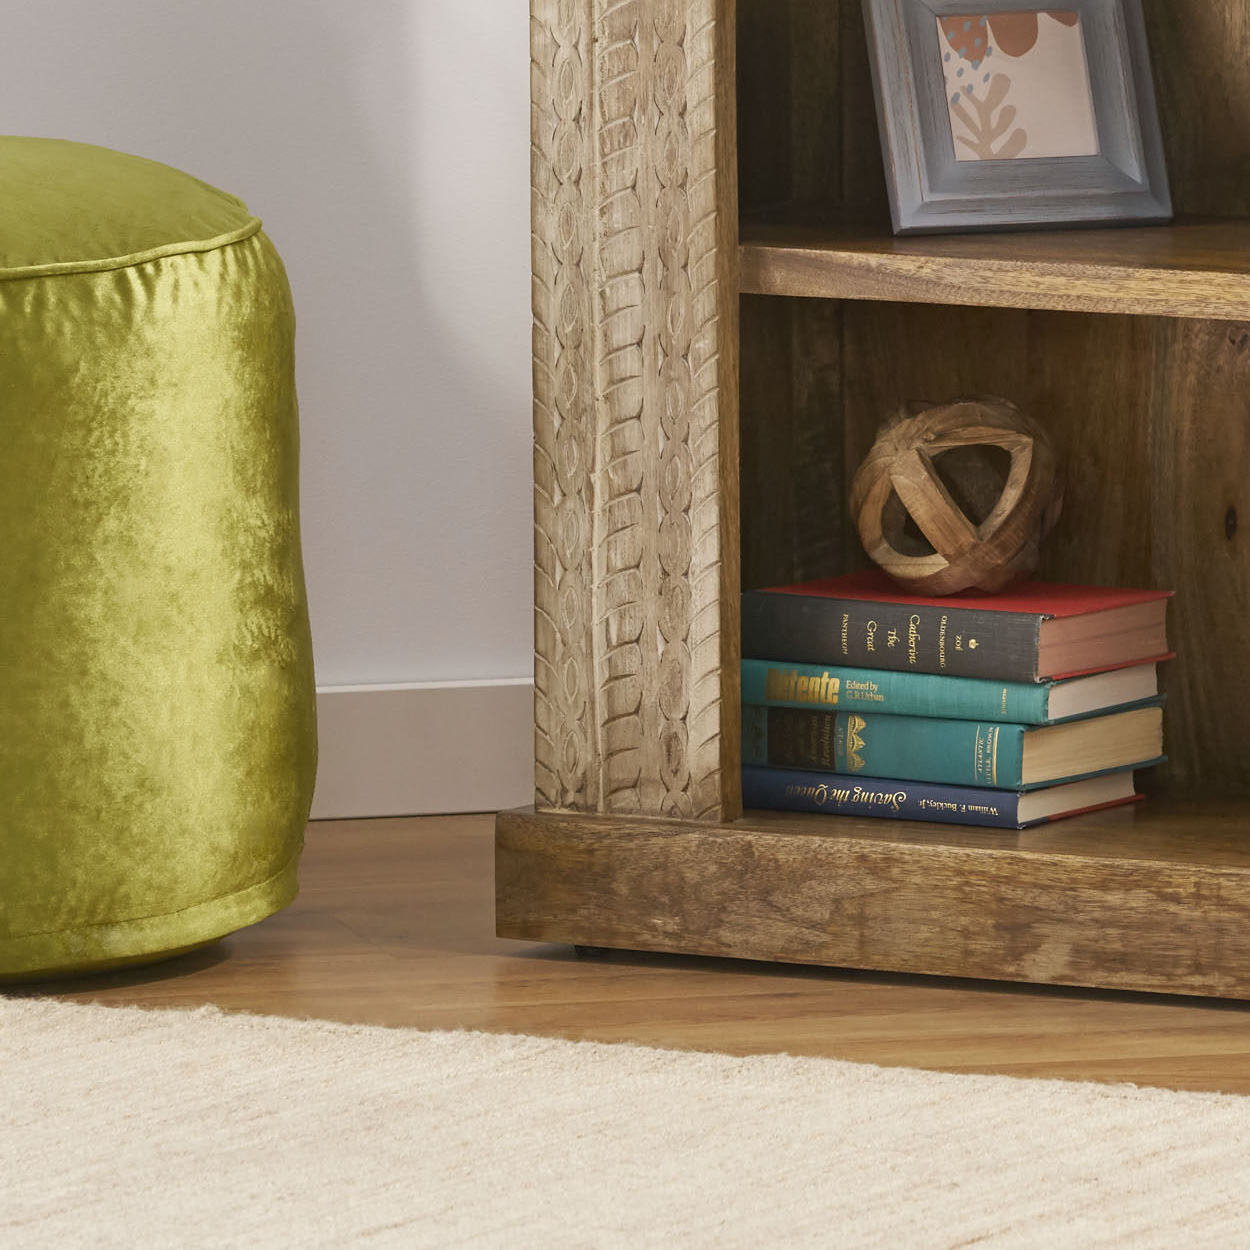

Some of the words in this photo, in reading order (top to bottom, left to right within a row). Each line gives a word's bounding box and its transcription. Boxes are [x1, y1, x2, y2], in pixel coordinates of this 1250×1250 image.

[841, 613, 849, 655] PANTHEON
[866, 620, 877, 652] Great
[887, 628, 900, 648] The
[908, 614, 920, 664] Catherine
[939, 615, 948, 668] OLDENBOURG
[869, 680, 879, 693] by
[831, 788, 850, 807] the
[852, 786, 907, 812] Saving
[967, 804, 999, 816] William
